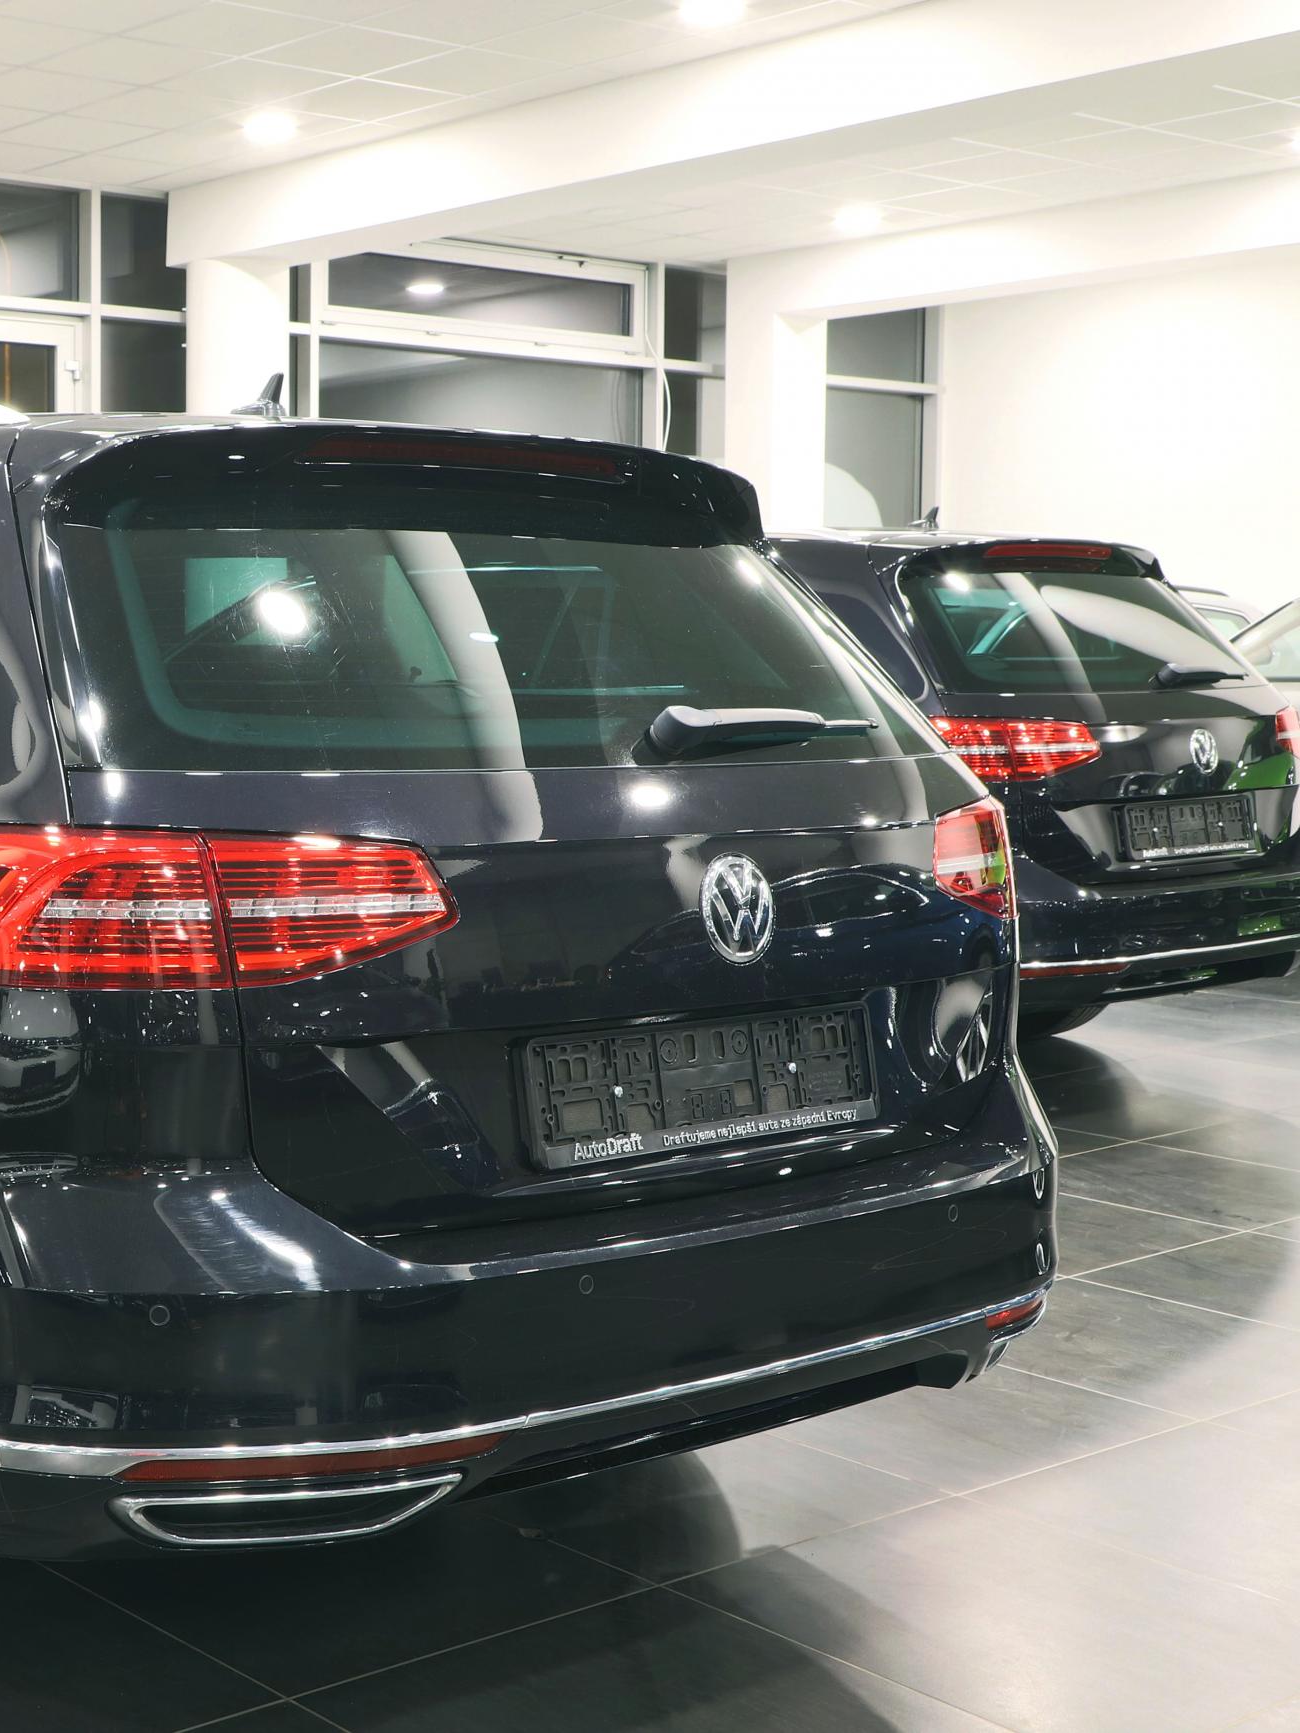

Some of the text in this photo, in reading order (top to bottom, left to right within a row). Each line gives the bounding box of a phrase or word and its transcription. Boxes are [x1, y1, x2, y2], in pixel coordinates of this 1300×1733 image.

[701, 853, 775, 965] VW
[574, 1132, 644, 1160] AutoDraft
[663, 1128, 716, 1146] Draftujeme
[758, 1118, 779, 1132] auta
[779, 1117, 791, 1129] ze
[826, 1108, 857, 1121] Evropy
